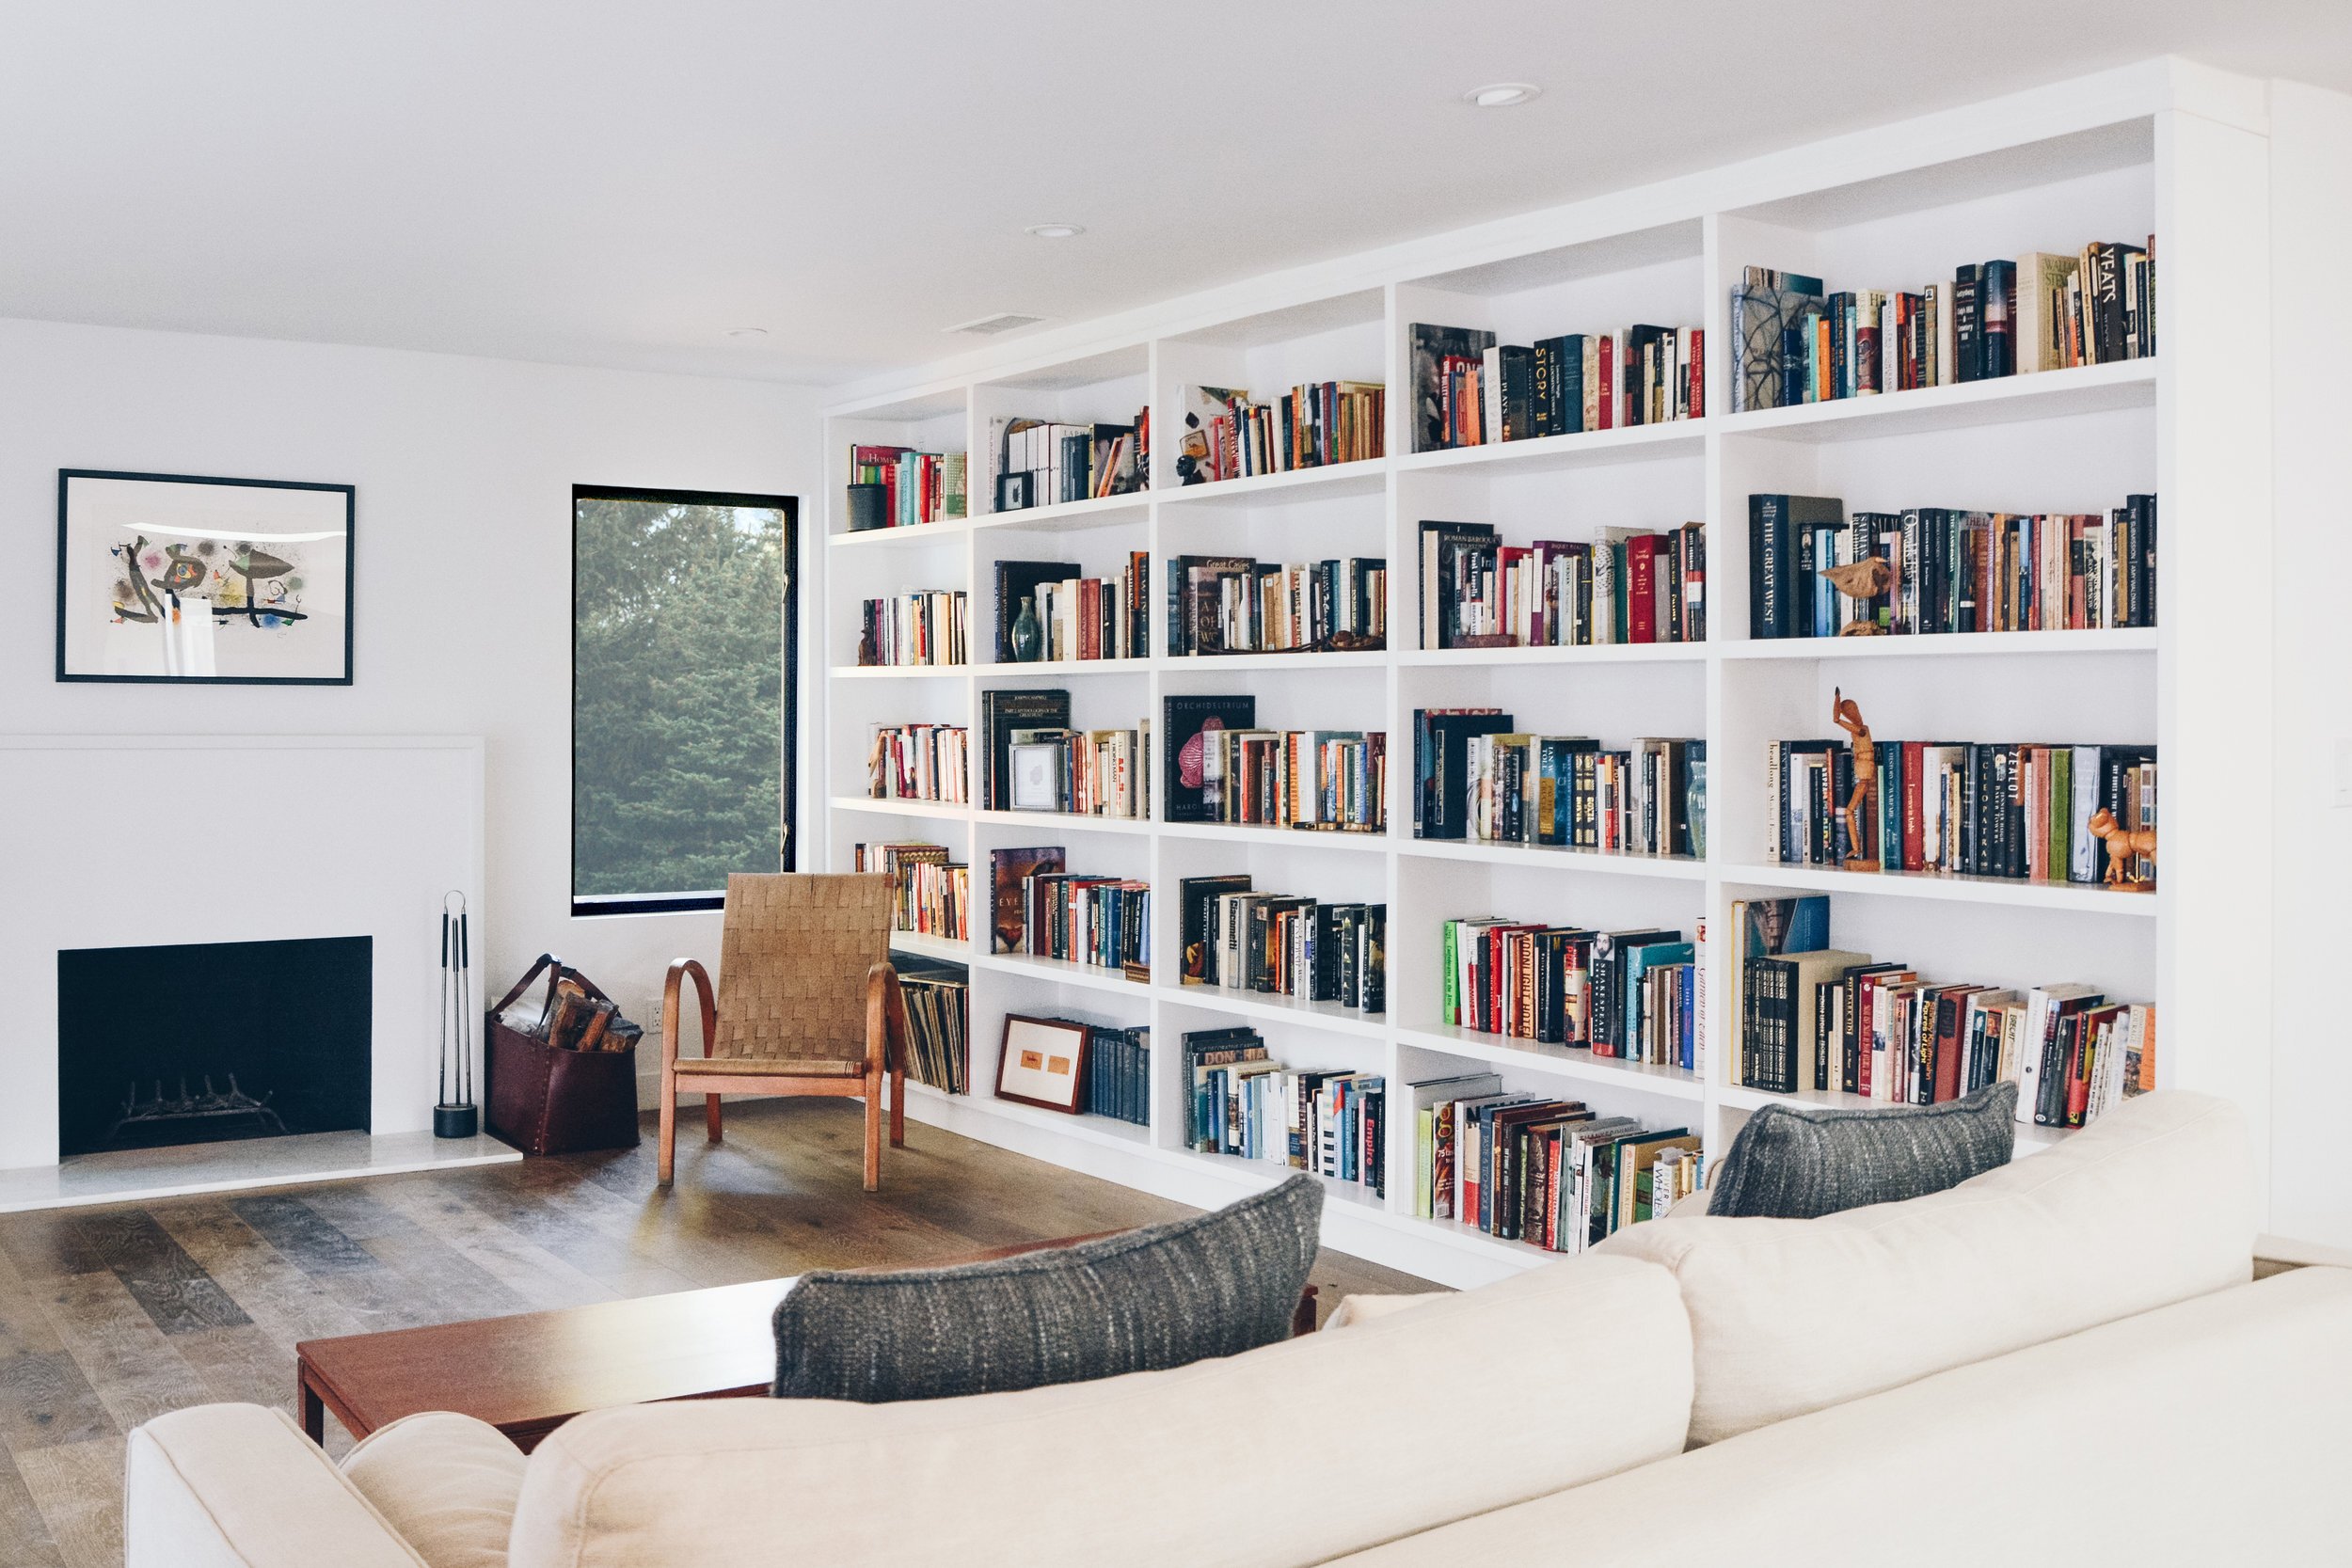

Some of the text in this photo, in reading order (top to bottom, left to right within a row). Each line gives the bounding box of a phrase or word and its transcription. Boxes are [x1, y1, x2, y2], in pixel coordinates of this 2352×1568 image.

[1535, 346, 1547, 400] STORY
[1764, 519, 1775, 546] THE
[1764, 546, 1775, 588] GREAT
[1764, 589, 1775, 625] WEST
[1768, 743, 1778, 788] headlong
[2008, 751, 2019, 800] ZEALOT
[1228, 904, 1239, 955] Giacometti
[1521, 932, 1532, 1001] MOONLIGHT
[1819, 994, 1827, 1014] JOHN
[1921, 1000, 1931, 1064] Figures of Light
[1926, 1002, 1935, 1081] Stanley Kauffmann
[1365, 1118, 1375, 1166] Empire
[1479, 1134, 1488, 1156] TASTE
